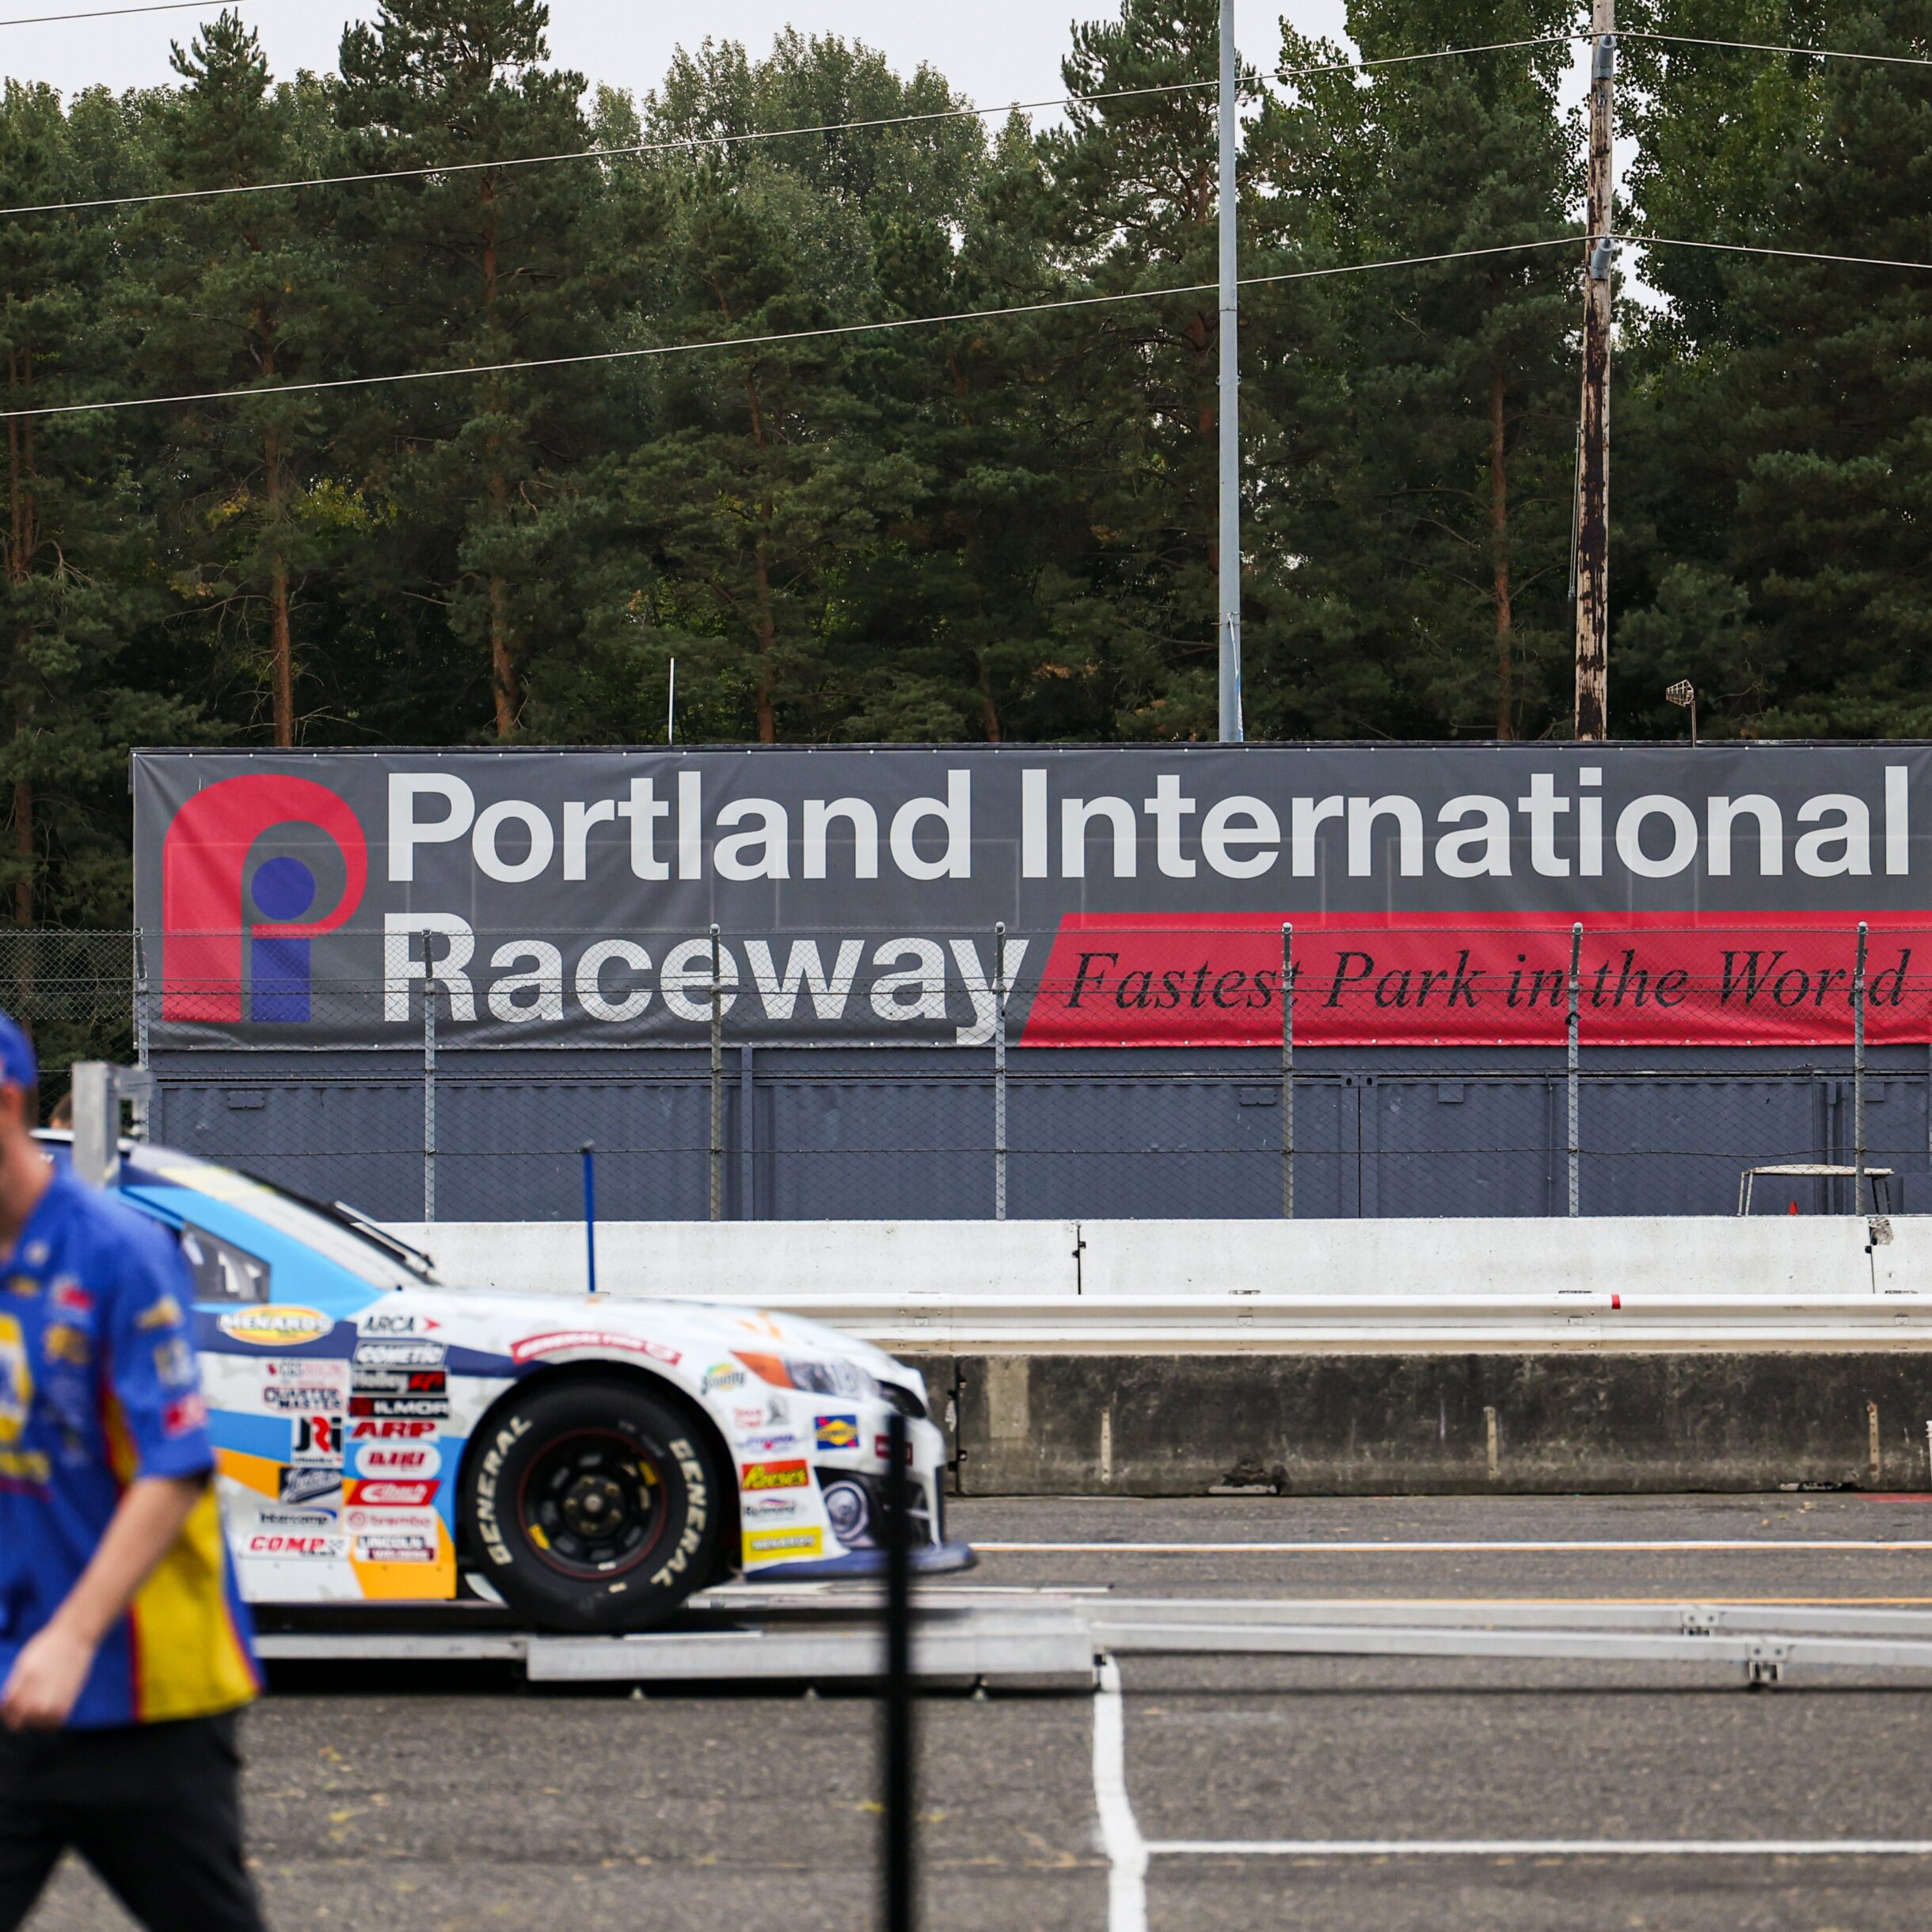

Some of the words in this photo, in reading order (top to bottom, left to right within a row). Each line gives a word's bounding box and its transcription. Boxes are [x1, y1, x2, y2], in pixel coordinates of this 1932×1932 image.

[388, 770, 971, 883] Portland
[1022, 766, 1909, 879] International
[384, 912, 1029, 1045] Raceway
[1322, 949, 1486, 1009] Park
[1507, 953, 1565, 1008] in
[1591, 949, 1690, 1008] the
[219, 1314, 334, 1333] MENARDS
[365, 1316, 414, 1332] ARCA
[374, 1400, 449, 1415] ILMOR
[352, 1421, 435, 1438] ARP
[477, 1417, 533, 1565] GENERAL
[370, 1514, 431, 1527] brembo
[650, 1438, 707, 1588] GENERAL
[249, 1535, 325, 1552] COMP
